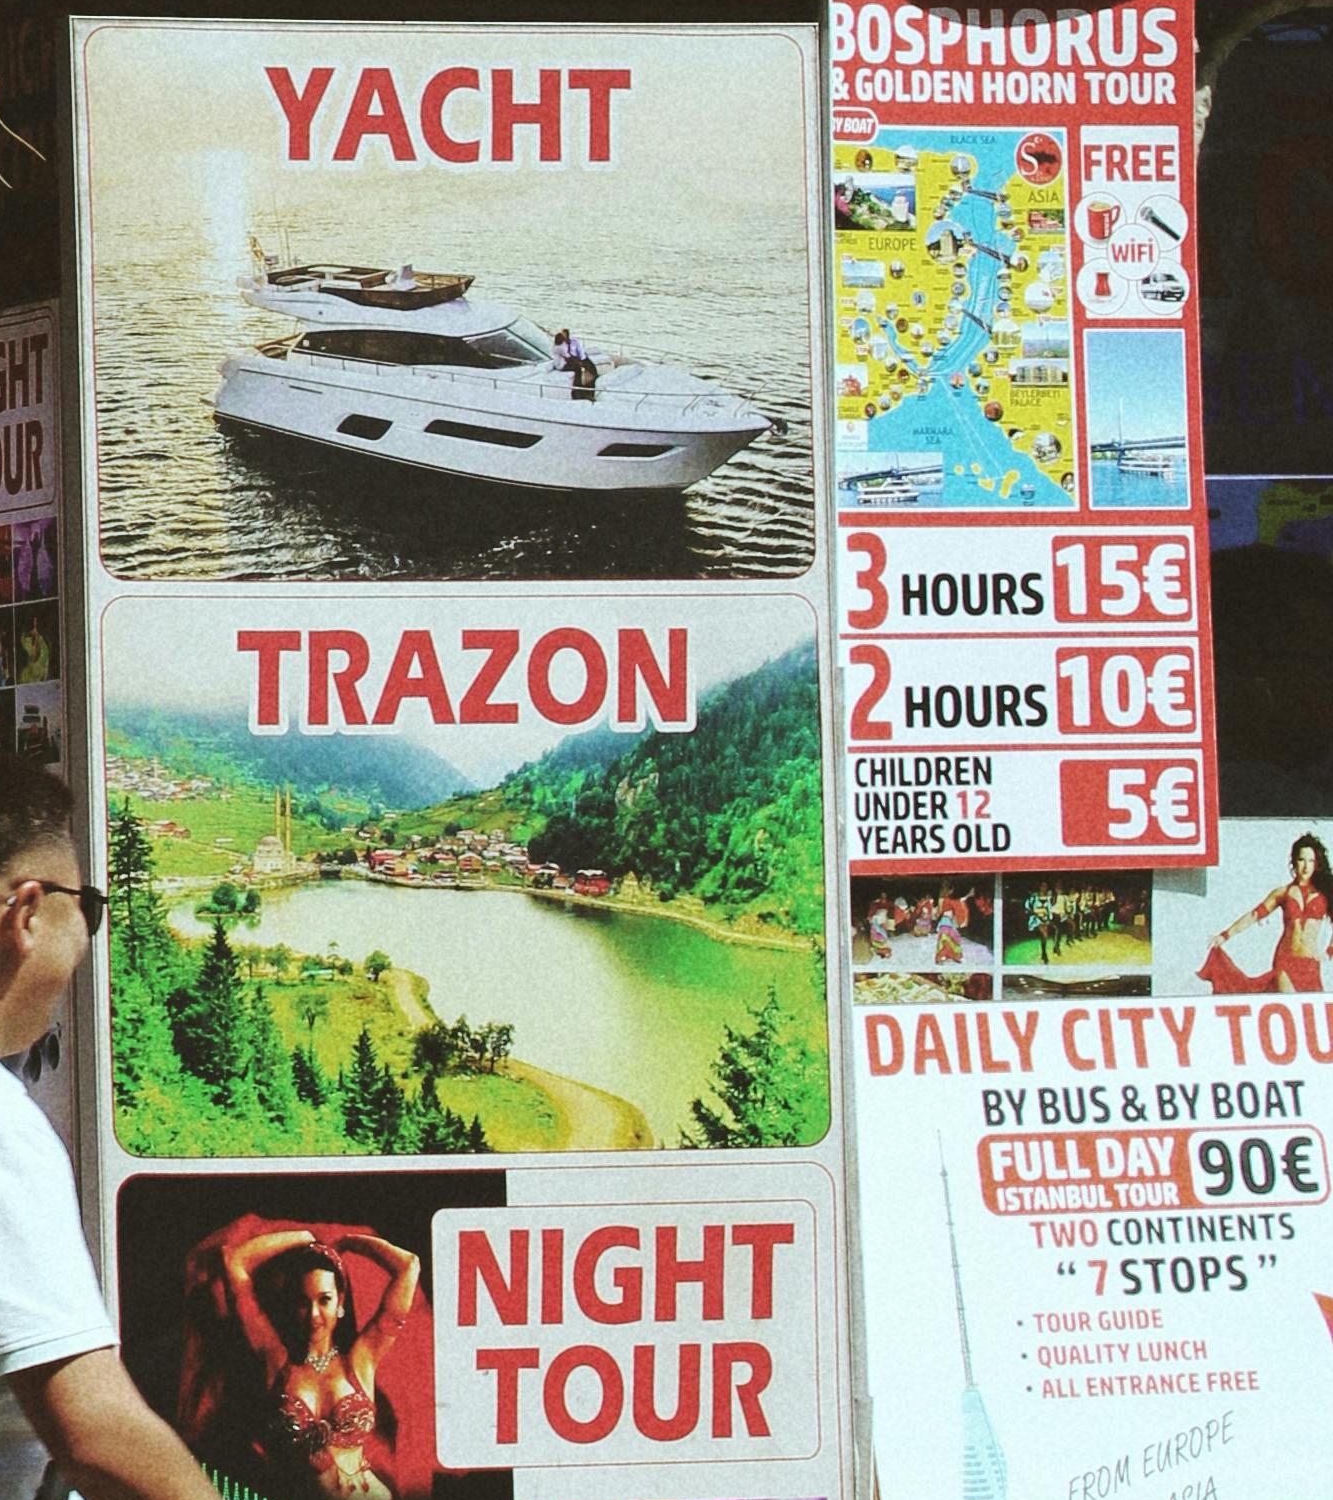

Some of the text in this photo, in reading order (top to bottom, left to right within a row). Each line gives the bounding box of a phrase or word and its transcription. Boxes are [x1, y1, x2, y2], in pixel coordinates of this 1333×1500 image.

[833, 3, 1179, 67] BOSPHORUS
[264, 67, 631, 162] YACHT
[855, 71, 1076, 104] GOLDEN HORN
[1084, 143, 1176, 182] FREE
[901, 543, 1188, 617] HOURS 15€
[237, 628, 689, 726] TRAZON
[1059, 654, 1192, 727] 10€
[855, 757, 992, 787] CHILDREN
[855, 766, 1197, 840] UNDER 5€
[864, 1010, 1039, 1077] DAILY
[1061, 1006, 1196, 1072] CITY
[982, 1080, 1305, 1126] BY BY BOAT
[457, 1223, 795, 1327] NIGHT
[1033, 1308, 1163, 1332] TOUR GUIDE
[476, 1343, 773, 1445] TOUR
[1143, 1411, 1235, 1478] EUROPE
